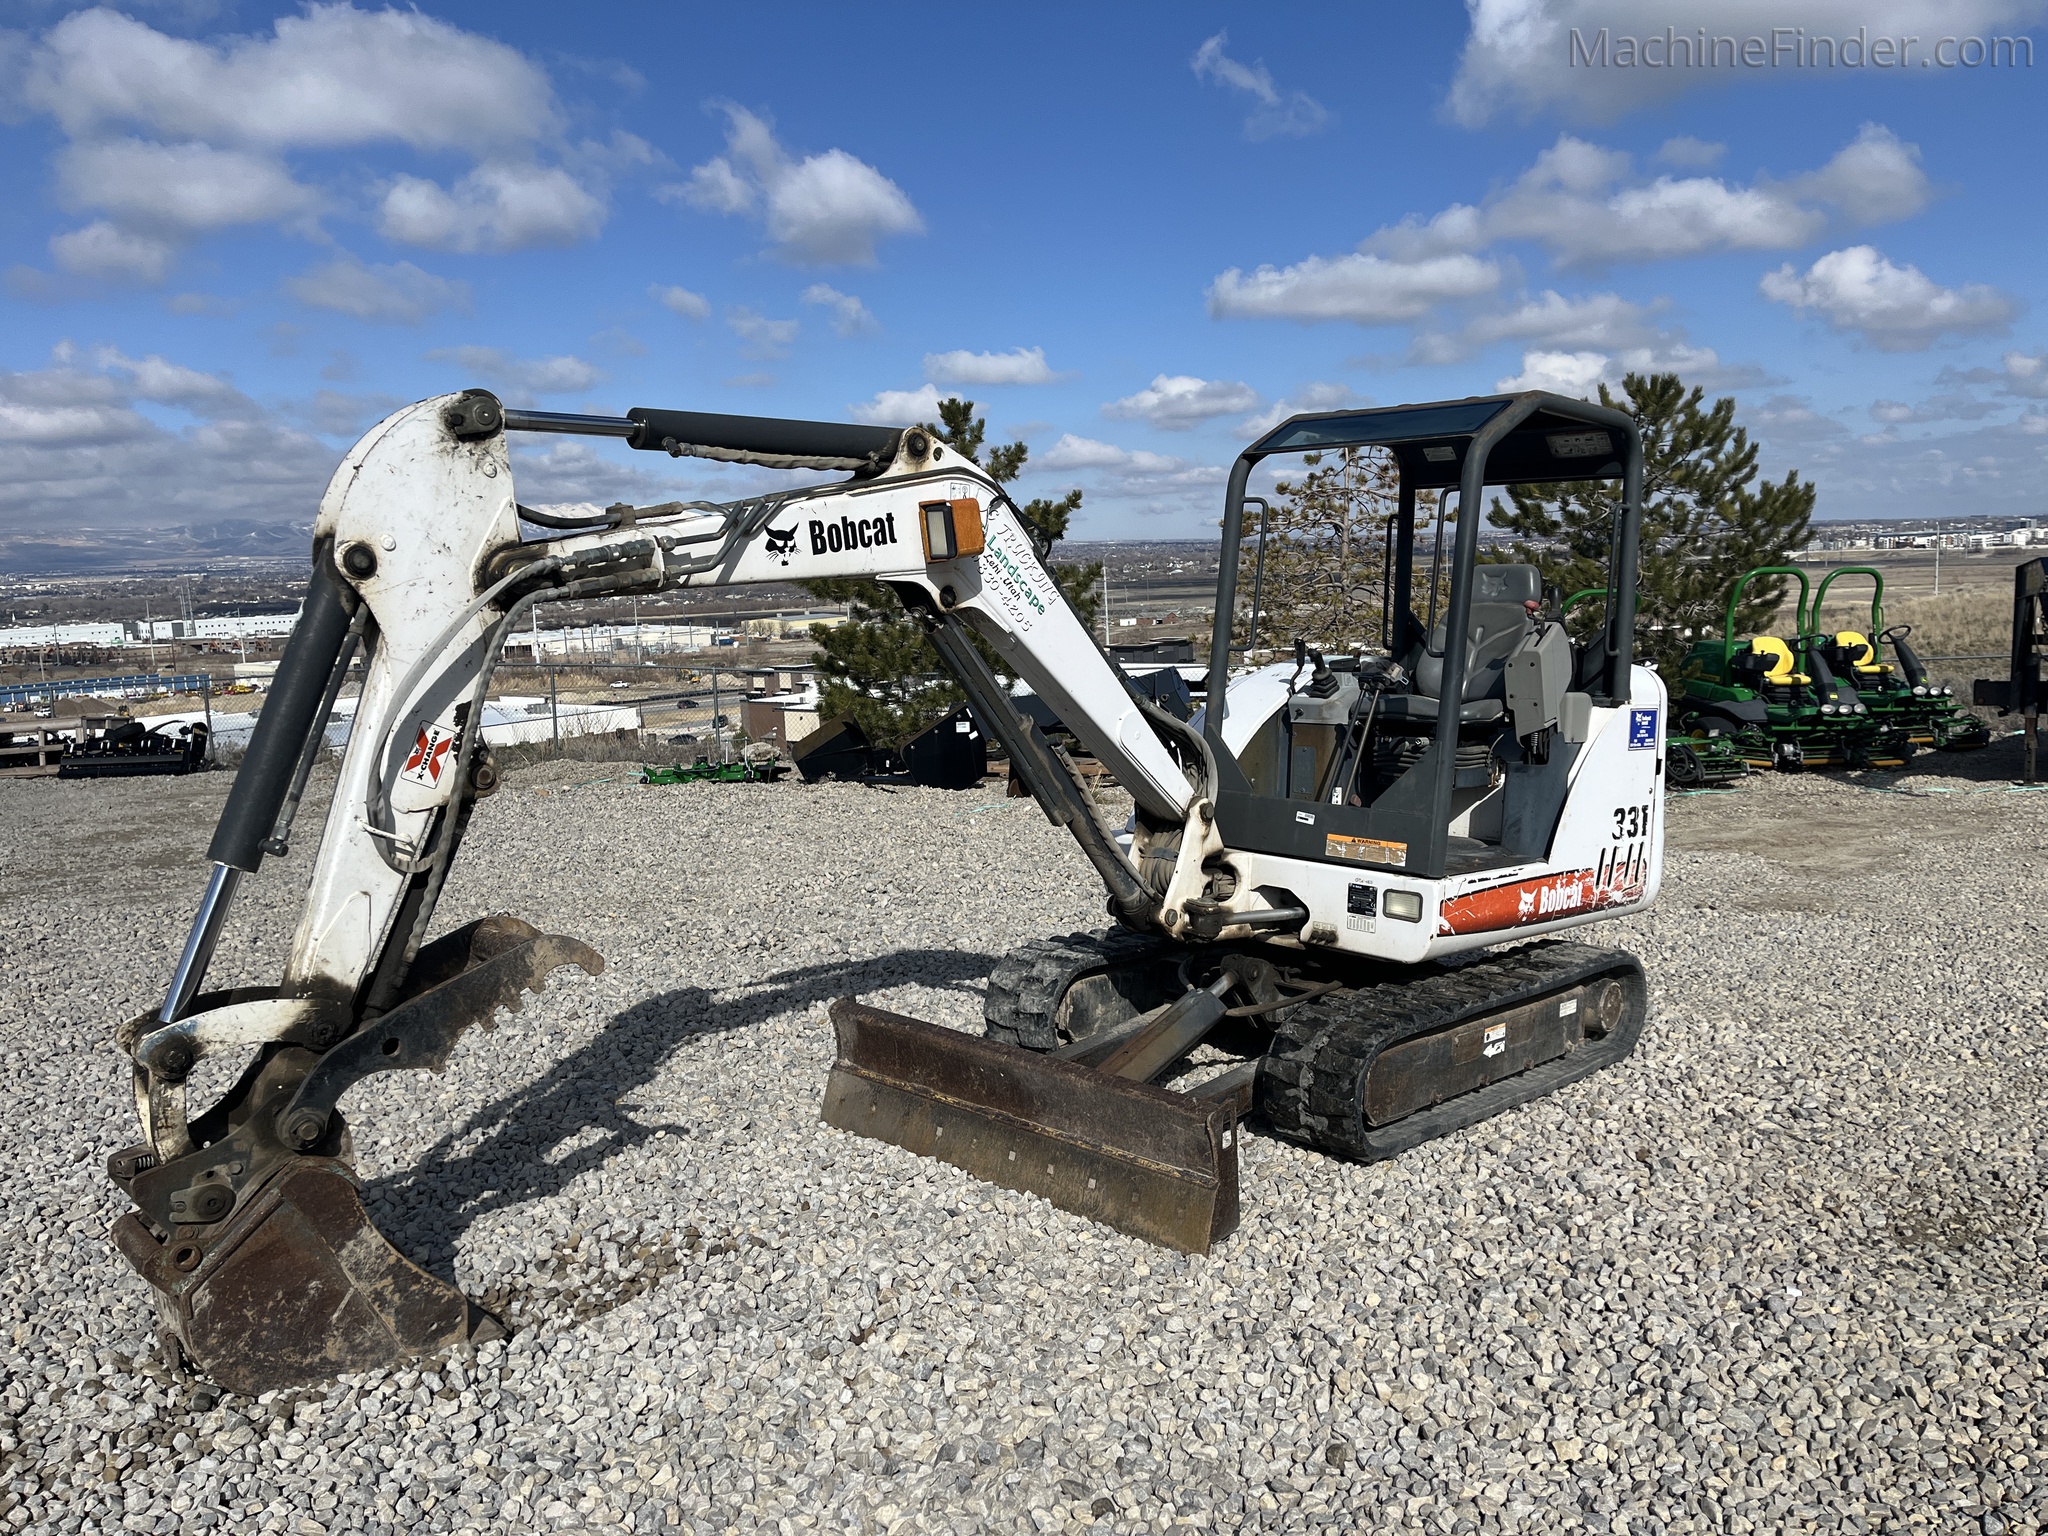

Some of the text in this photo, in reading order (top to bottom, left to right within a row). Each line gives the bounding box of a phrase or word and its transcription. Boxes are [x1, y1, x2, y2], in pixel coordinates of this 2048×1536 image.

[809, 511, 896, 555] Bobcat
[983, 553, 1003, 575] Lehi
[986, 534, 1046, 616] Landscape
[417, 729, 440, 780] X-CHANGE
[1612, 804, 1648, 840] 331
[1357, 838, 1381, 846] WARNING
[1539, 881, 1584, 914] Bobcat
